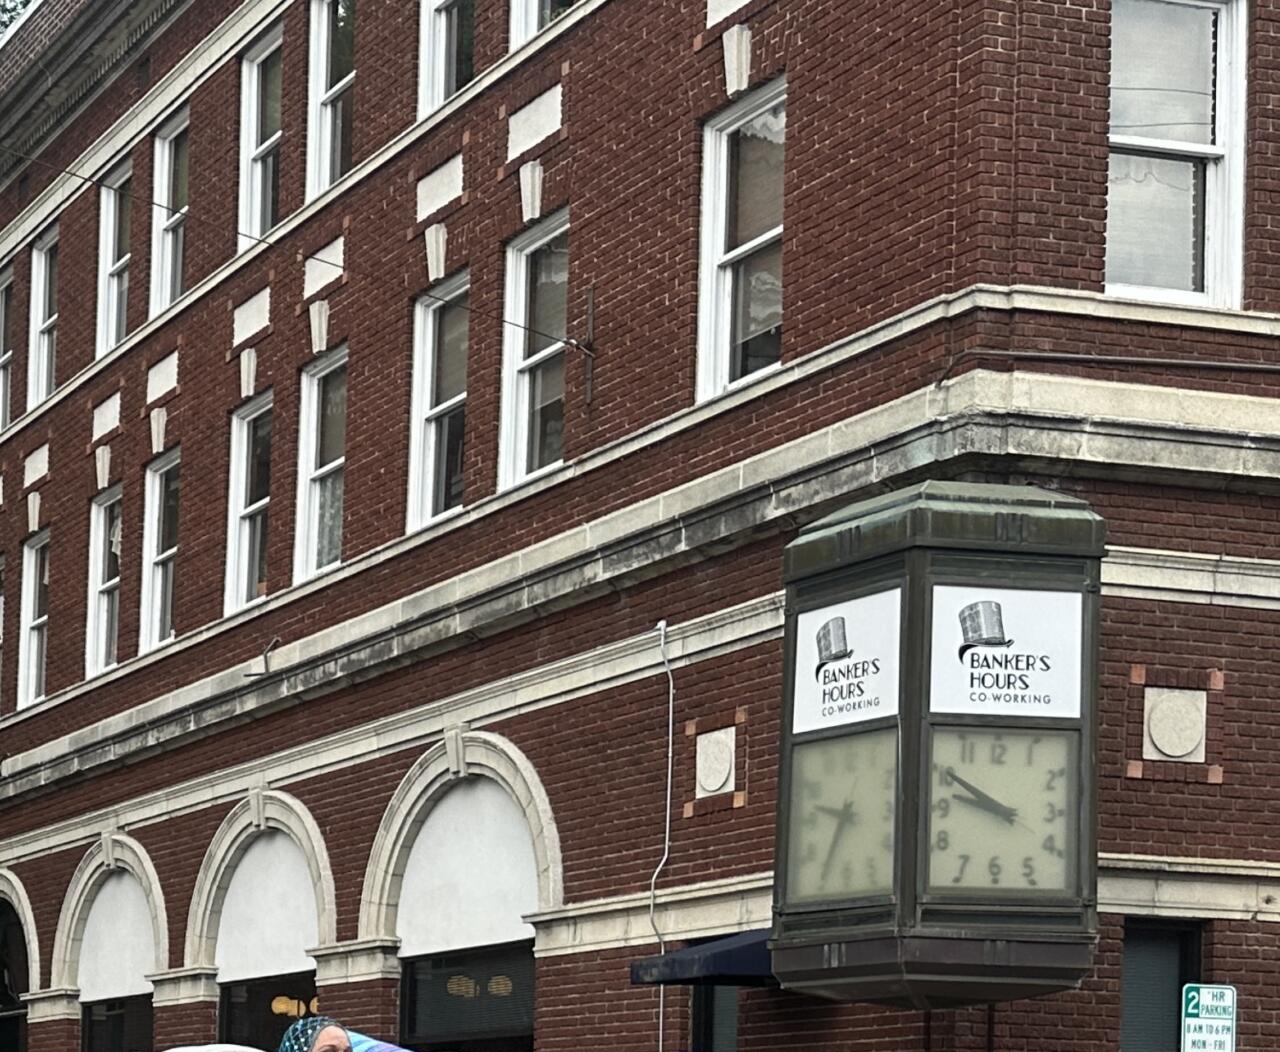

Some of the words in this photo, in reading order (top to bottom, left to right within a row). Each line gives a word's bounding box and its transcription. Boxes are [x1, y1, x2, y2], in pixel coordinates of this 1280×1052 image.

[823, 658, 880, 685] BANKER'S
[970, 652, 1051, 671] BANKER'S
[970, 672, 1030, 690] HOURS
[822, 681, 865, 704] HOURS
[970, 692, 1051, 704] CO-WORKING
[822, 697, 880, 717] CO-WORKING
[961, 741, 975, 763] 11
[991, 743, 1006, 765] 12
[1046, 769, 1057, 790] 2
[937, 798, 950, 818] 9
[1043, 802, 1056, 822] 3
[936, 830, 949, 850] 8
[1042, 834, 1055, 853] 4
[958, 855, 970, 878] 7
[988, 856, 1002, 876] 6
[1022, 857, 1034, 877] 5
[1188, 991, 1199, 1013] 2
[1212, 992, 1225, 1002] HR
[1201, 1005, 1231, 1016] PARKING
[1193, 1024, 1203, 1034] AM
[1206, 1024, 1214, 1034] TO
[1215, 1025, 1220, 1035] 6
[1221, 1025, 1231, 1035] PM
[1191, 1039, 1206, 1049] MON
[1214, 1040, 1226, 1050] FRI
